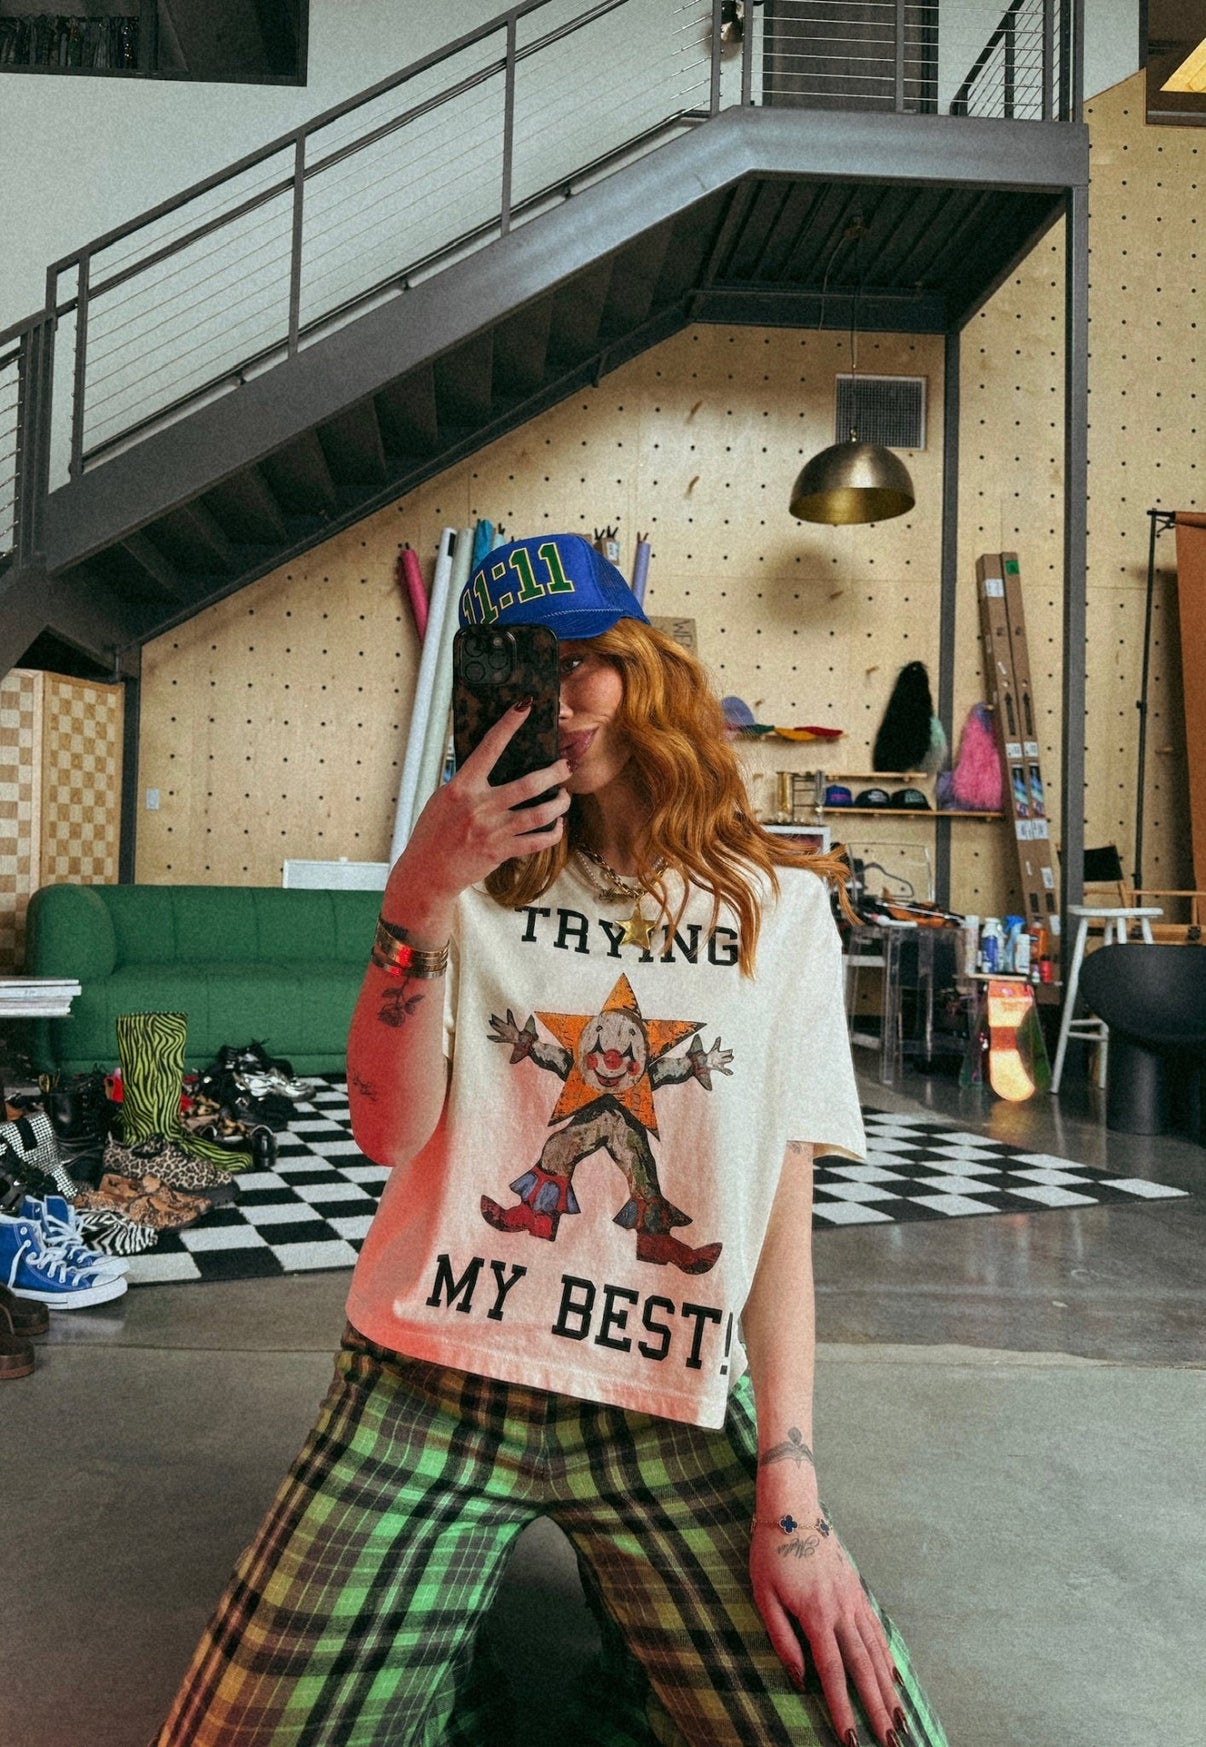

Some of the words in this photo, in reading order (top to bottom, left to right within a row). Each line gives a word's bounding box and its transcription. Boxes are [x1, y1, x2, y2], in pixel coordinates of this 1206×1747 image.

[462, 541, 576, 625] 11:11
[425, 1254, 528, 1322] MY
[551, 1274, 734, 1376] BEST!
